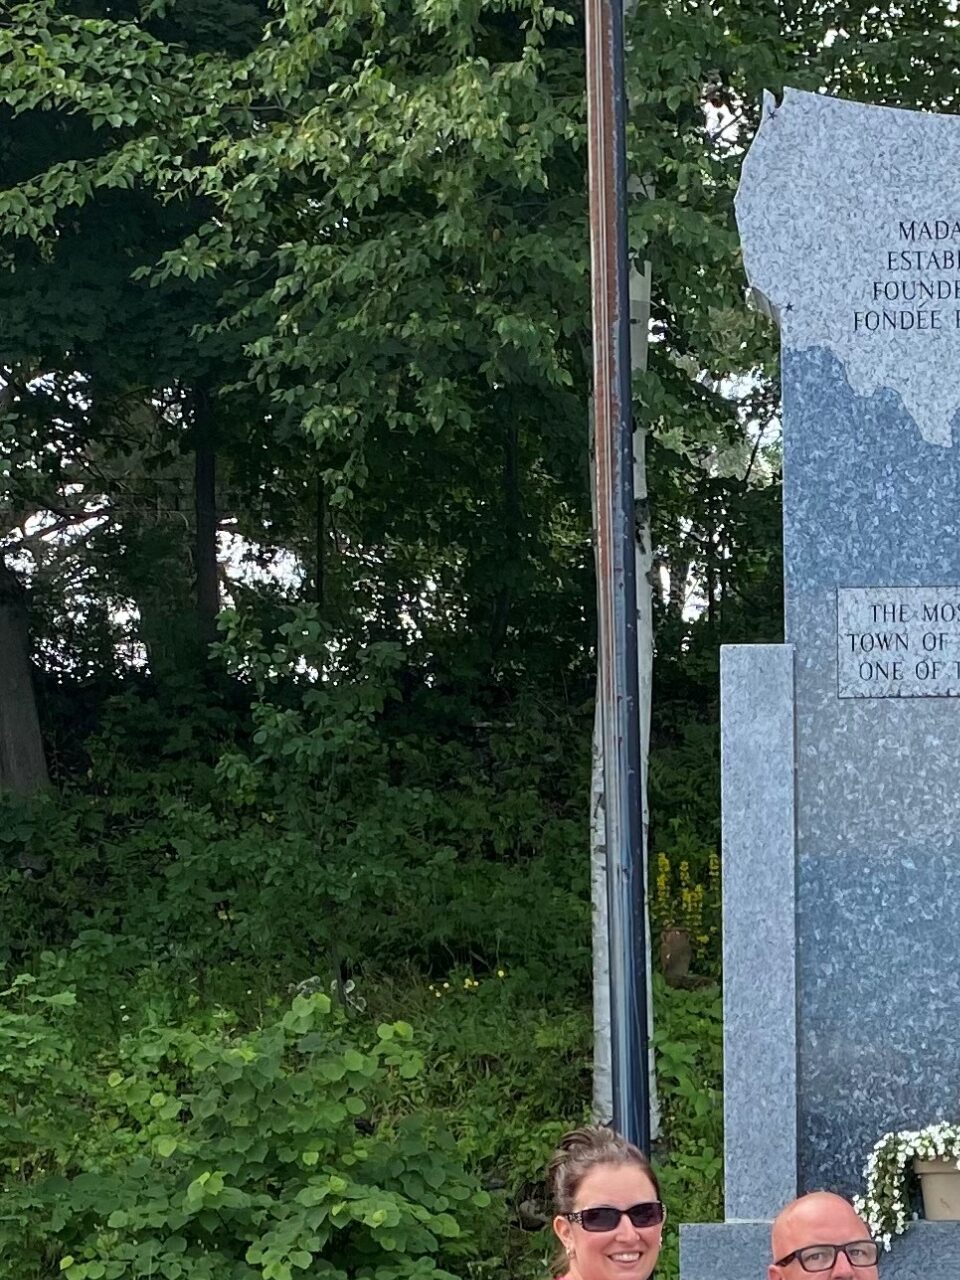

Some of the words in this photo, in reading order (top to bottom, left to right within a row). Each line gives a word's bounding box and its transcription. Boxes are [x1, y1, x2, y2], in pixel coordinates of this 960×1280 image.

[871, 604, 908, 623] THE
[847, 632, 909, 652] TOWN
[922, 632, 949, 652] OF
[859, 661, 904, 680] ONE
[915, 661, 941, 680] OF
